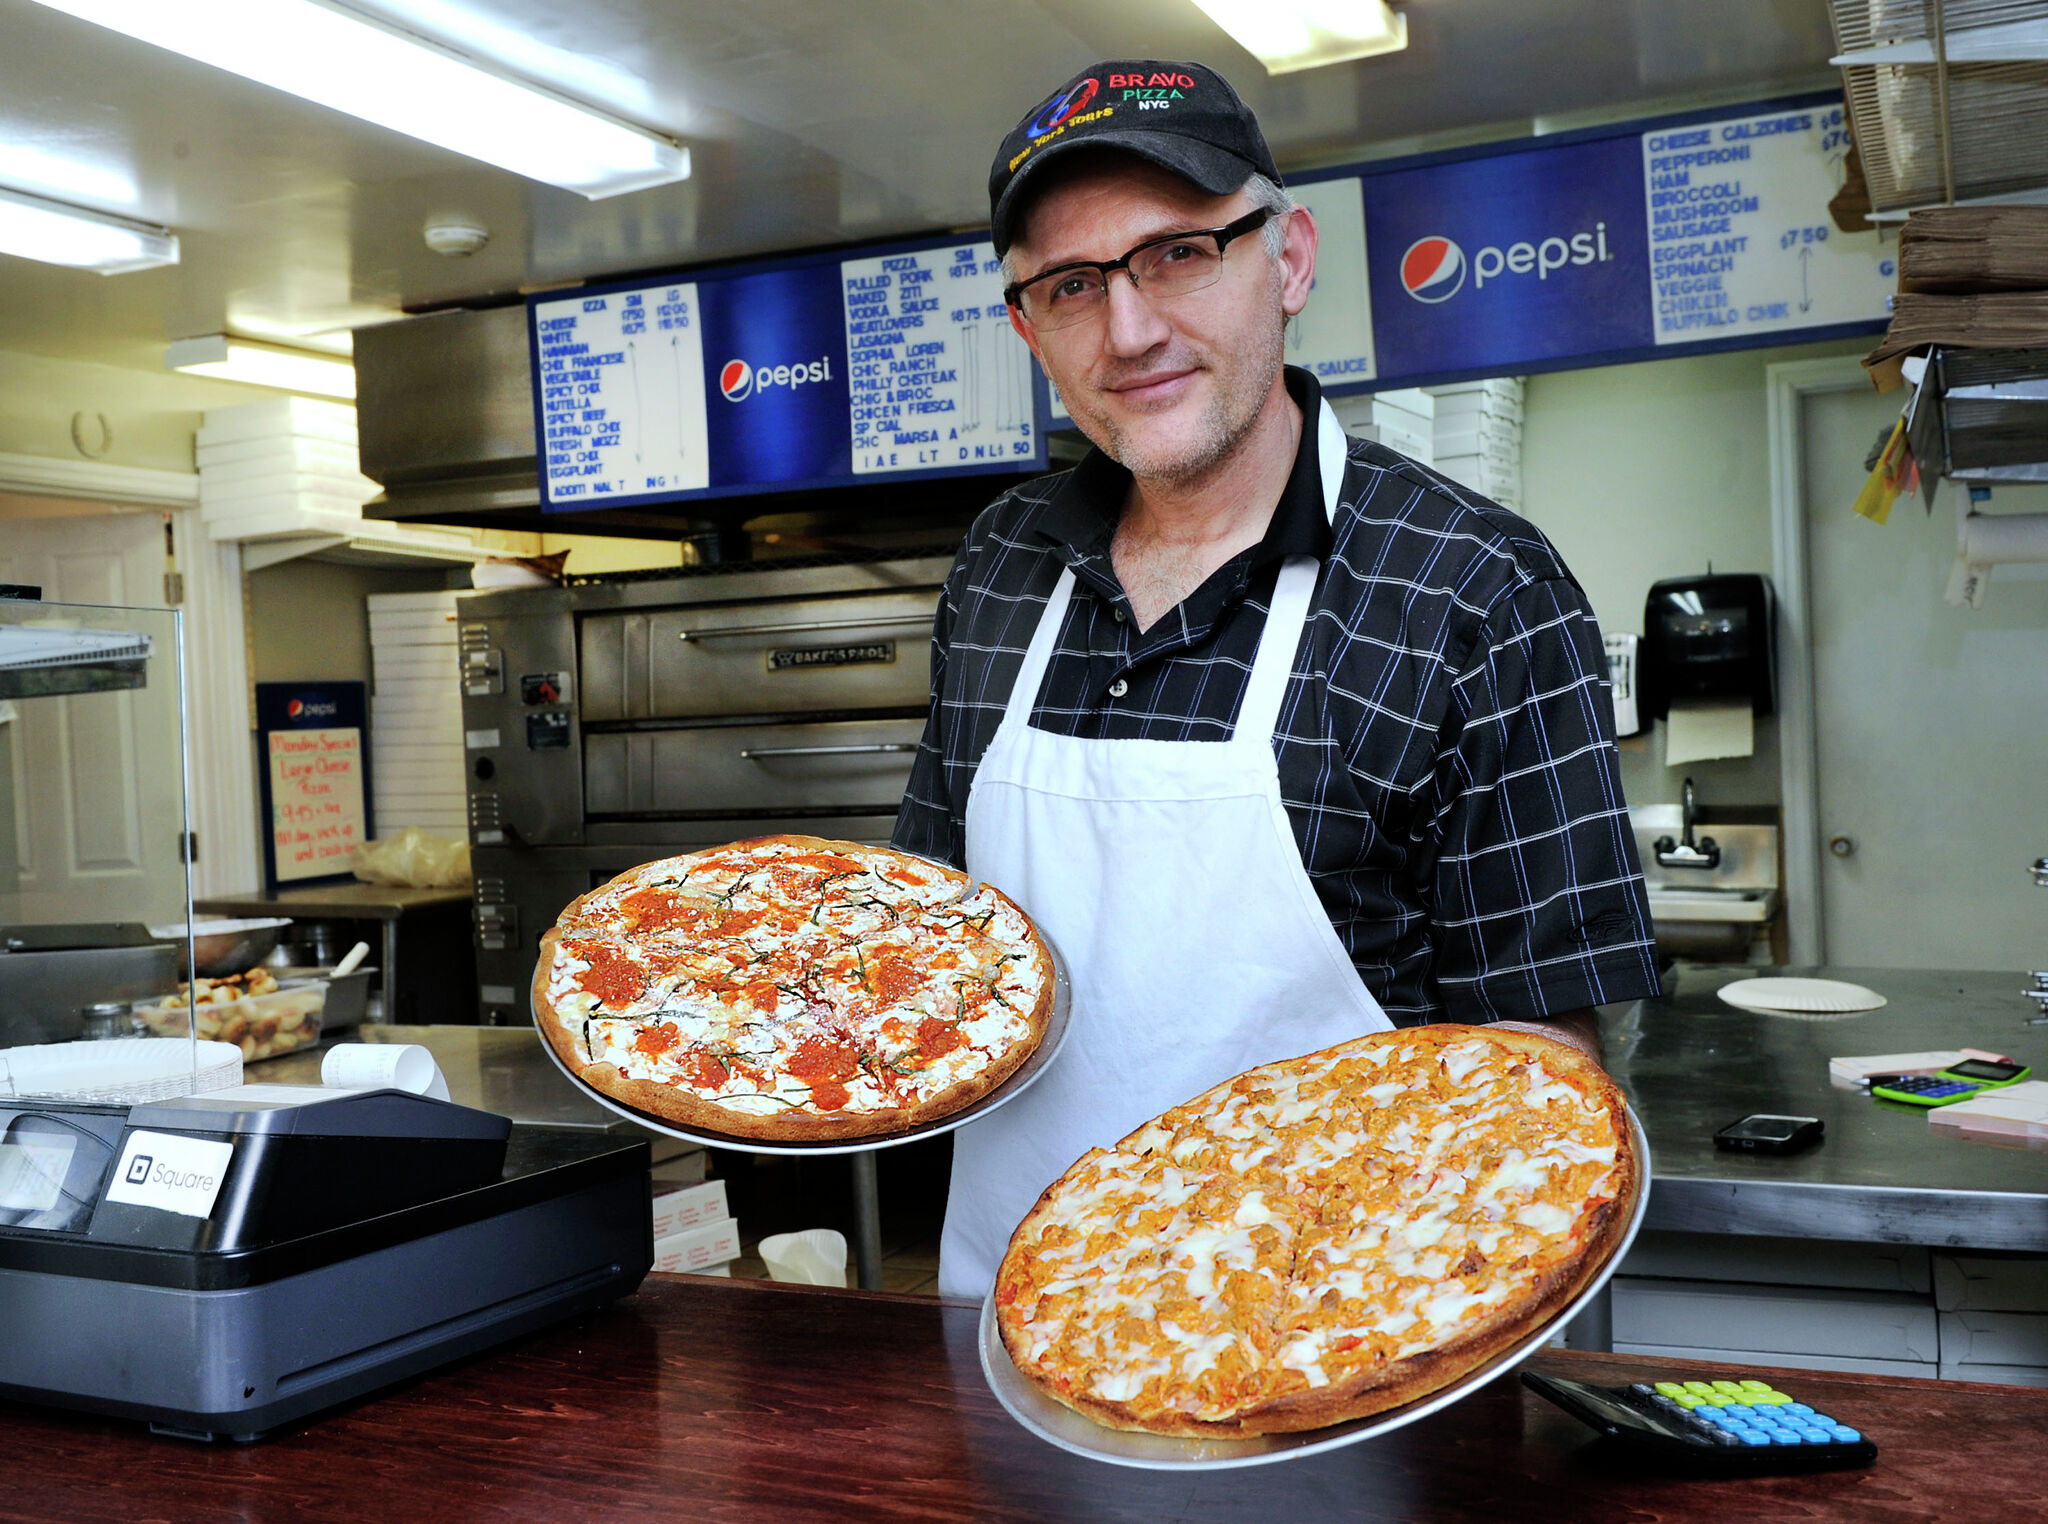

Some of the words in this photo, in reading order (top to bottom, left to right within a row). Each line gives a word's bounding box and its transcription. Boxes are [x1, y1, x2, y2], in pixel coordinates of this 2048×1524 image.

[1109, 72, 1195, 88] BRAVO
[1122, 88, 1185, 102] PIZZA
[1138, 101, 1170, 111] NYC
[1034, 124, 1065, 148] York
[1068, 106, 1114, 128] Tours
[1649, 129, 1712, 152] CHEESE
[1722, 114, 1813, 142] CALZONES
[1651, 144, 1751, 173] PEPPERONI
[1651, 171, 1690, 190] HAM
[1652, 180, 1741, 208] BROCCOLI
[1653, 196, 1759, 225] MUSHROOM
[1652, 217, 1731, 242] SAUSAGE
[1475, 222, 1607, 289] pepsi
[1654, 236, 1749, 263] EGGPLANT
[882, 256, 918, 272] PIZZA
[1654, 256, 1734, 281] SPINACH
[847, 274, 892, 291] PULLED
[899, 269, 935, 285] PORK
[1657, 275, 1723, 298] VEGGIE
[848, 290, 887, 306] BAKED
[899, 285, 922, 300] ZITI
[850, 304, 890, 320] VODKA
[900, 297, 940, 314] SAUCE
[849, 314, 925, 334] MEATLOVERS
[850, 331, 905, 350] LASAGNA
[851, 347, 895, 363] SOPHIA
[906, 341, 945, 357] LOREN
[756, 355, 830, 394] pepsi
[852, 363, 881, 378] CHIC
[889, 357, 936, 373] RANCH
[1317, 357, 1368, 377] SAUCE
[853, 376, 893, 392] PHILLY
[897, 386, 933, 402] BROC
[546, 397, 592, 412] NUTELLA
[908, 398, 956, 415] FRESCA
[152, 1162, 213, 1192] Square
